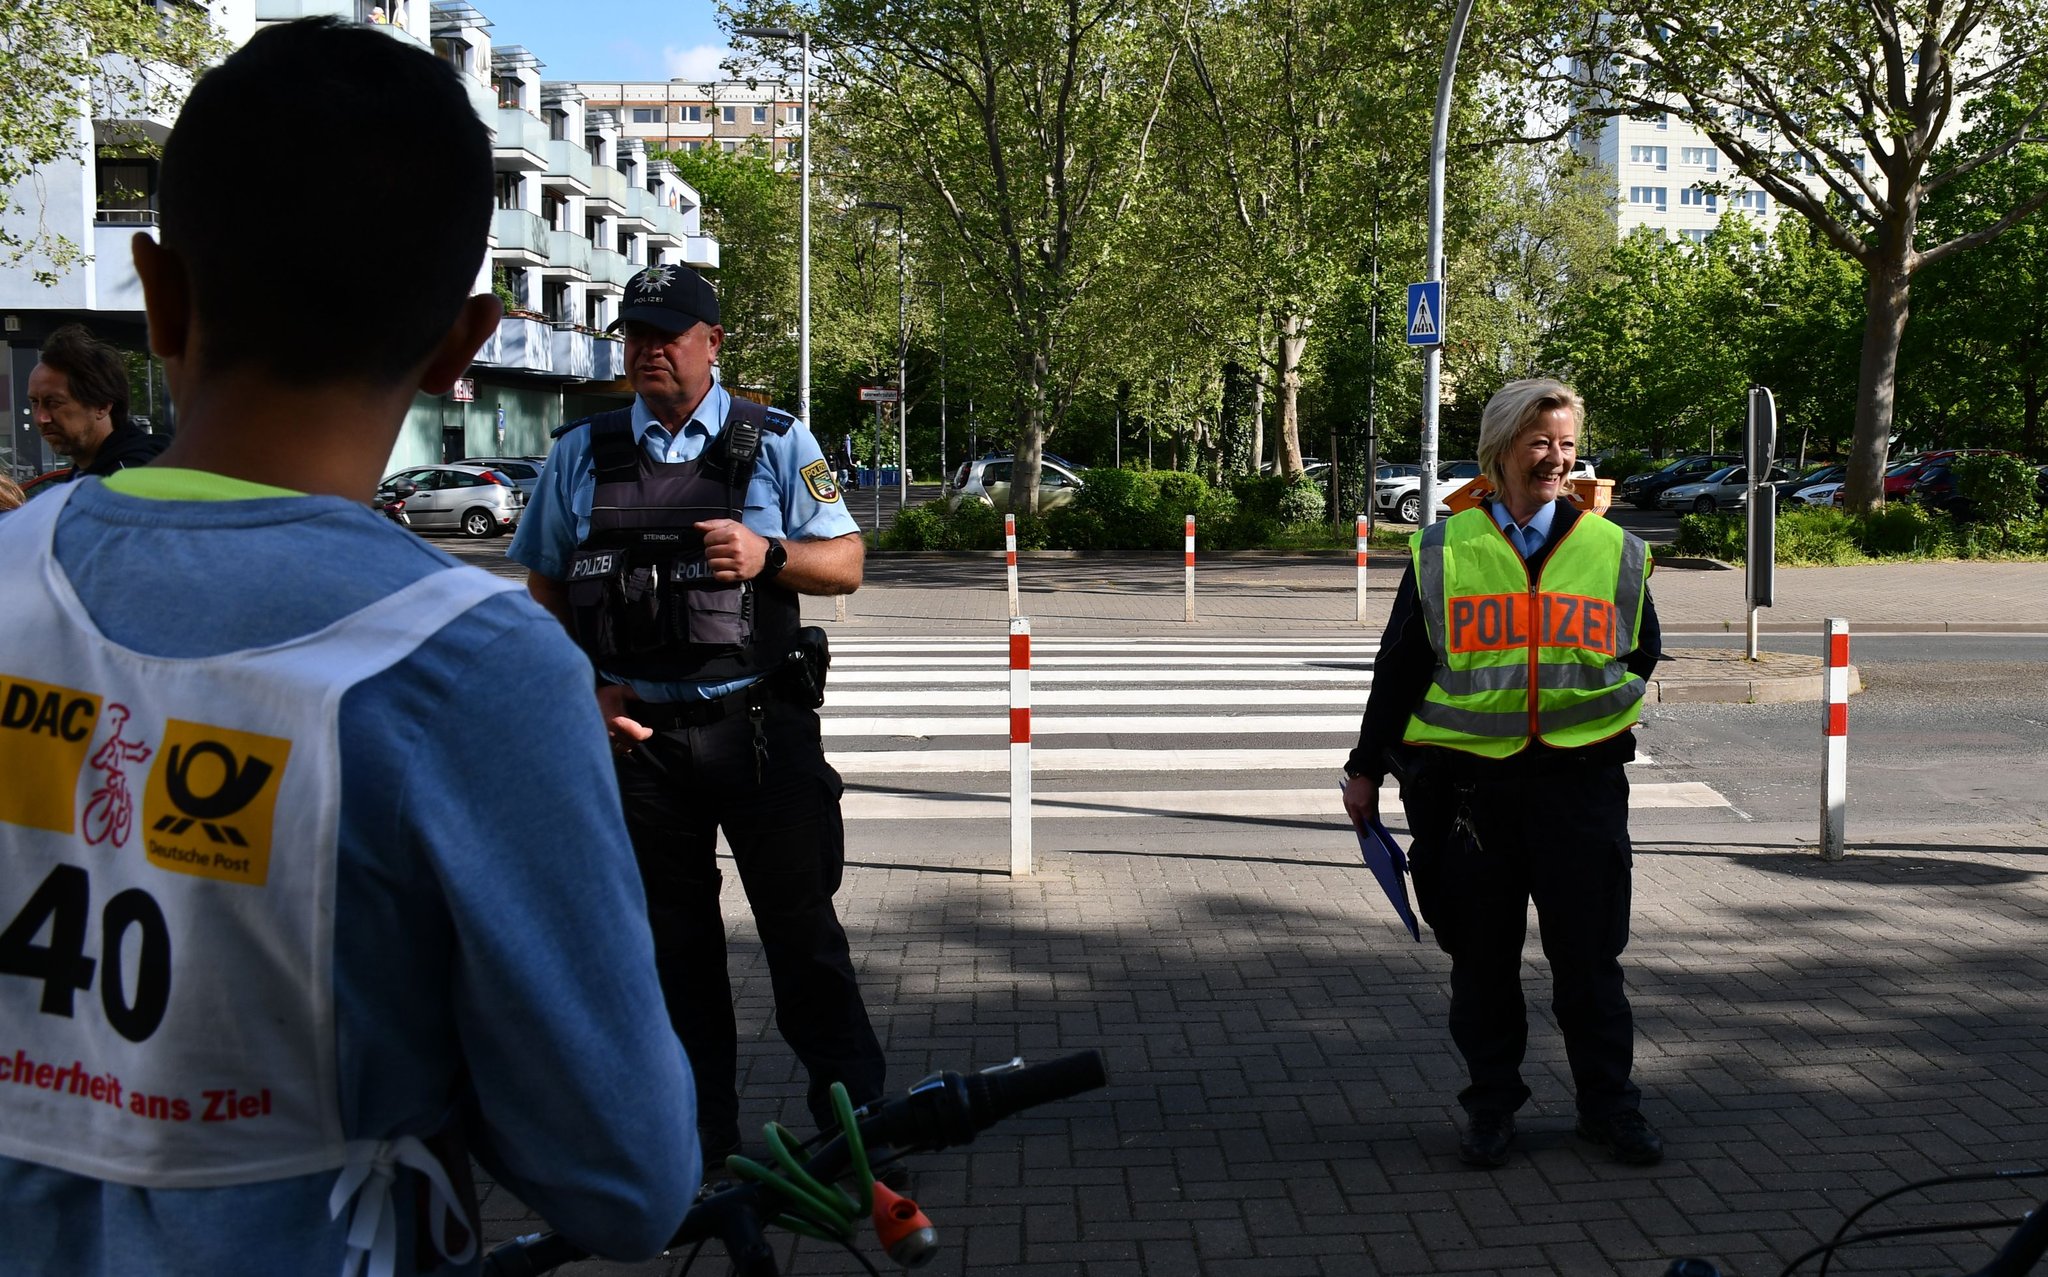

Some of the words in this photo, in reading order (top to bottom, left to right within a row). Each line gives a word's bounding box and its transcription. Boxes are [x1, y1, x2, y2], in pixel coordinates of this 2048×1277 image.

[633, 296, 664, 305] POLIZEI
[643, 533, 680, 541] STEINBACH
[572, 554, 613, 578] POLIZEI
[676, 561, 713, 579] POLI
[1453, 596, 1616, 651] POLIZEI
[0, 683, 95, 743] DAC
[149, 839, 210, 866] Deutsche
[213, 852, 250, 874] Post
[0, 862, 172, 1044] 40
[129, 1090, 191, 1122] ans
[201, 1088, 272, 1122] Ziel
